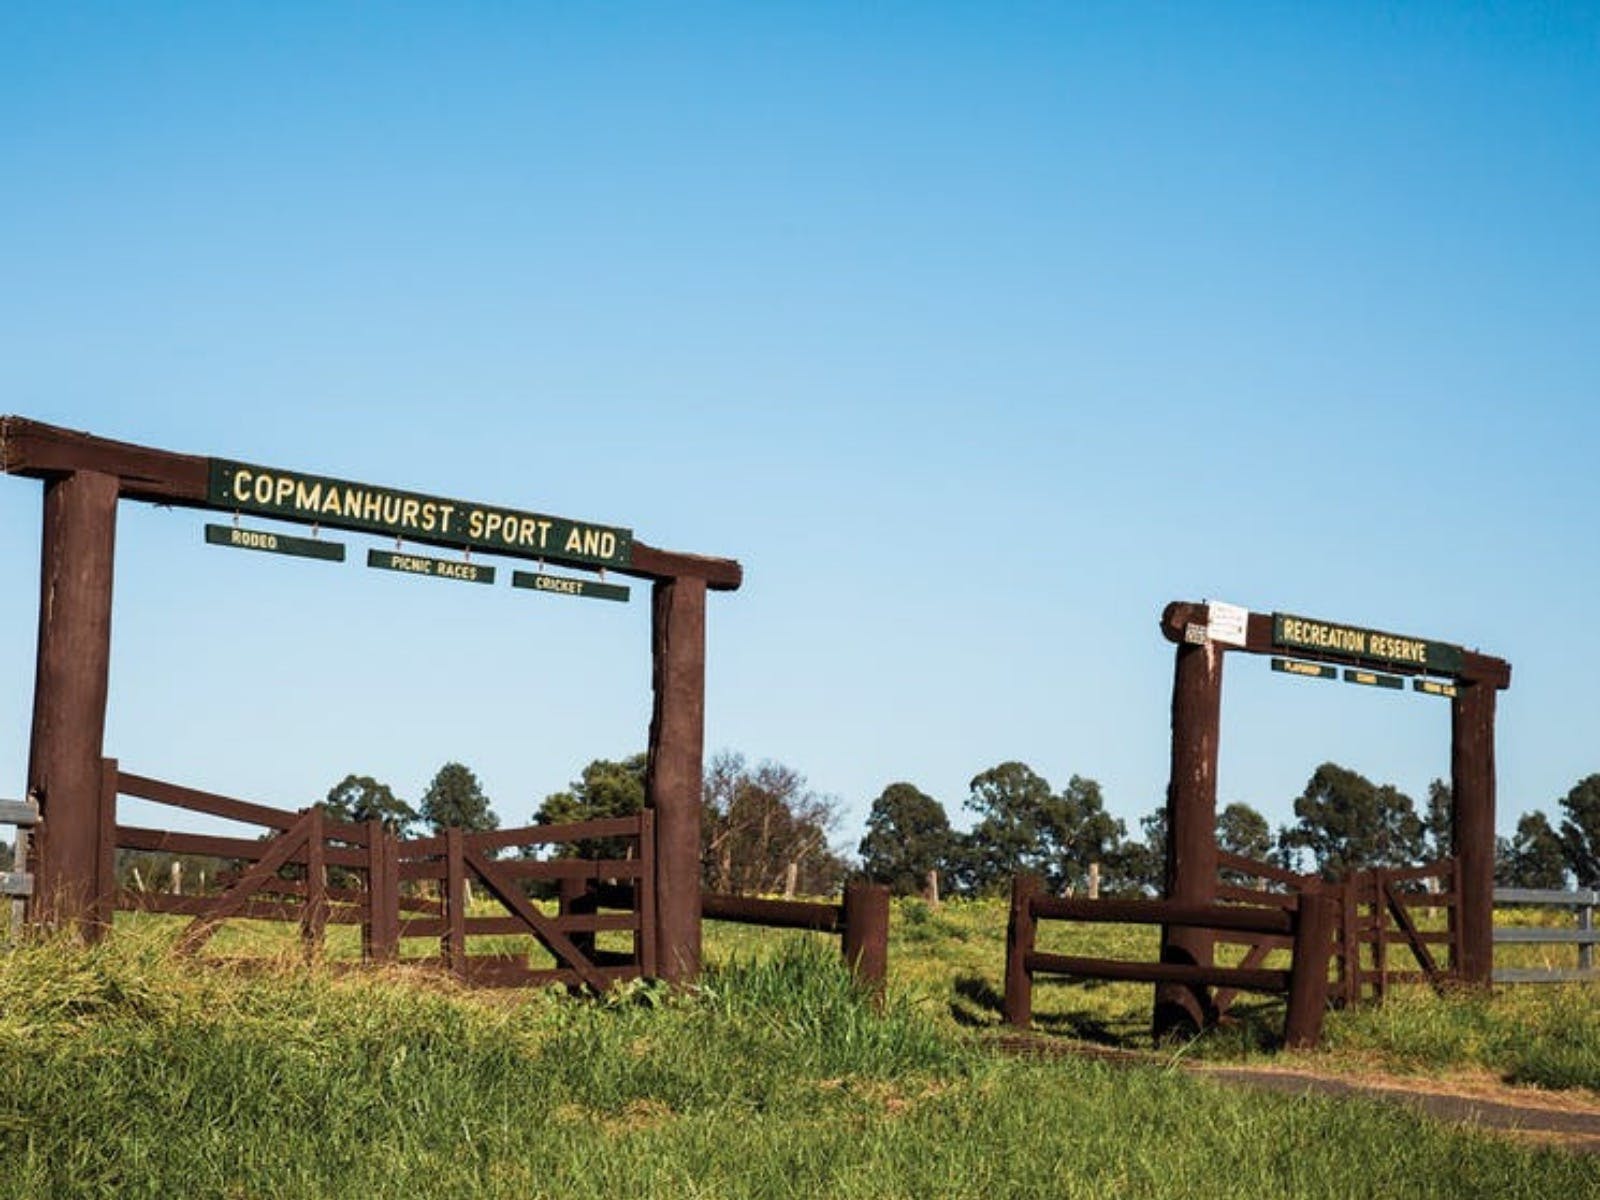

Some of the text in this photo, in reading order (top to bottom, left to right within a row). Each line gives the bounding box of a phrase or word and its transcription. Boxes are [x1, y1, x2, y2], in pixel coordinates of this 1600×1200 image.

[233, 470, 616, 560] COPMANHURST SPORT AND
[231, 530, 277, 549] RODEO
[391, 555, 477, 581] PICNIC RACES
[535, 576, 584, 595] CRICKET
[1284, 619, 1427, 663] RECREATION RESERVE
